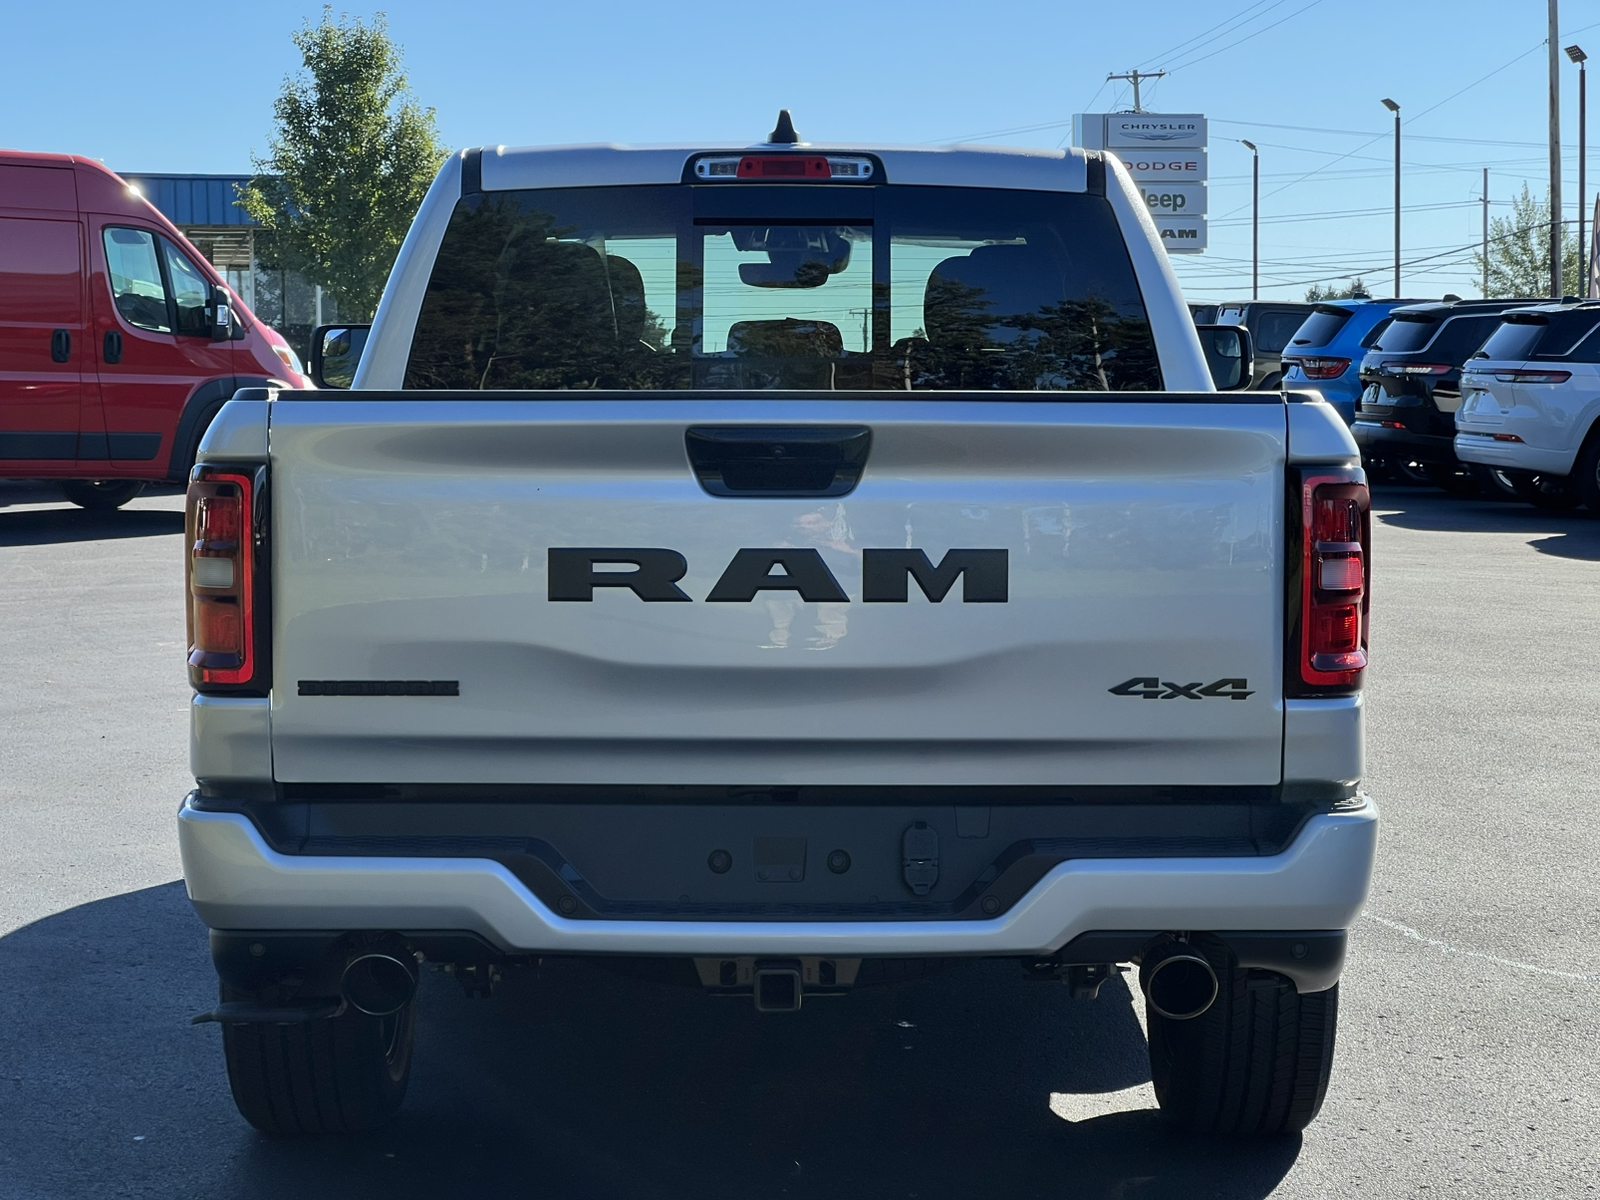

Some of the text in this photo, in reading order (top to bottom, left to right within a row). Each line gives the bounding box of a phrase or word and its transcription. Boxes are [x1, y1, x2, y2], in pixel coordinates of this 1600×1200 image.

[1160, 229, 1198, 239] AM
[548, 548, 1009, 603] RAM
[1108, 677, 1255, 701] 4x4
